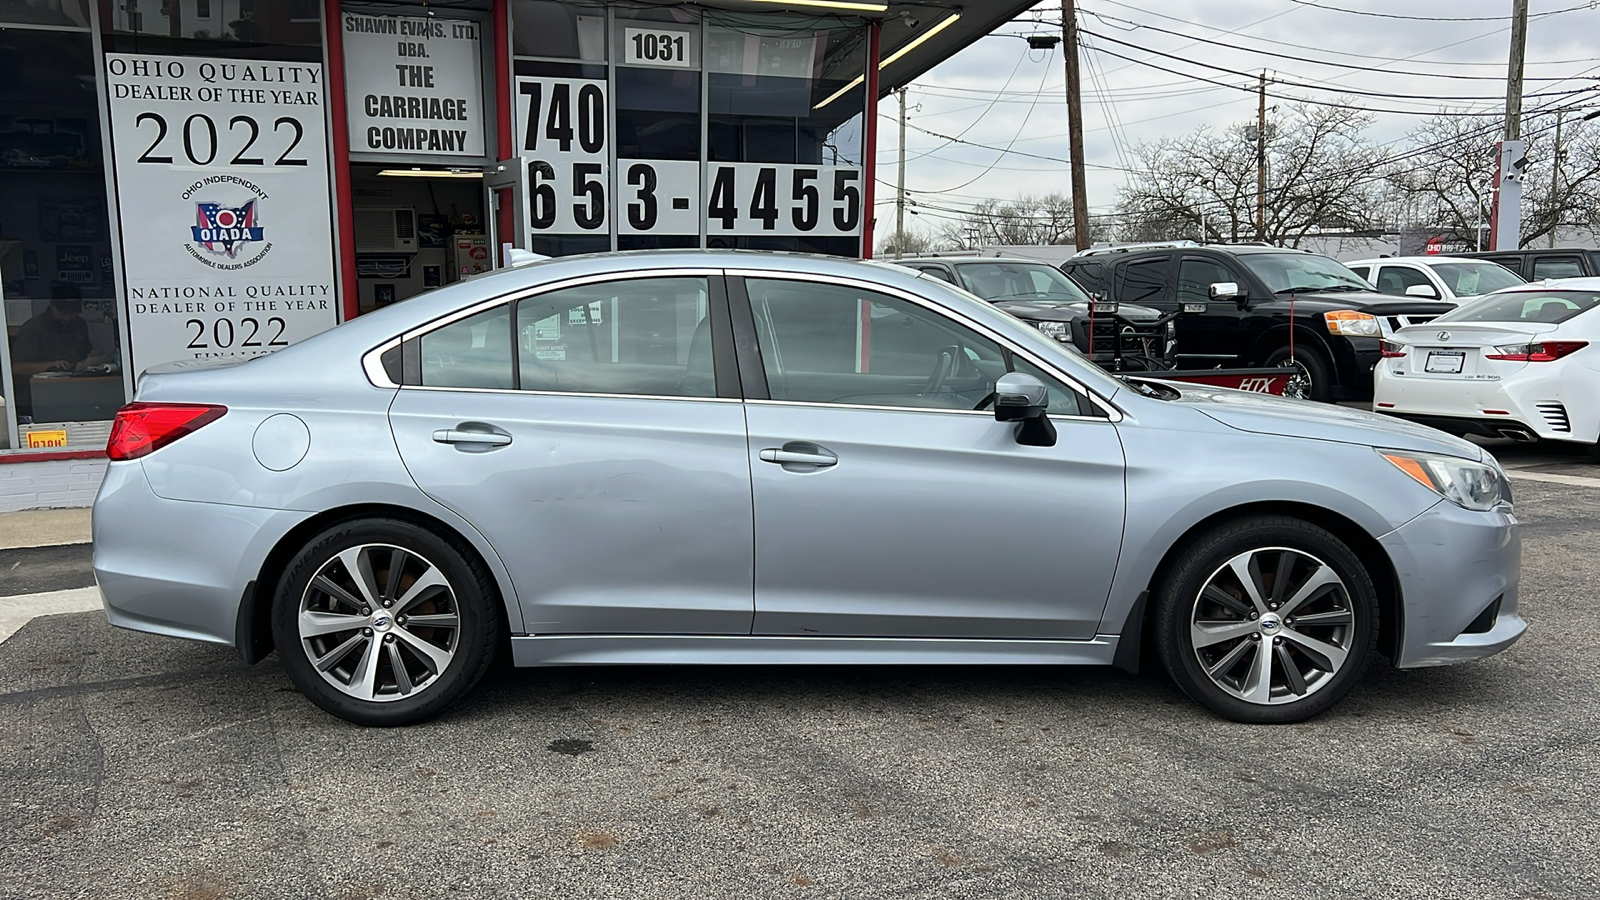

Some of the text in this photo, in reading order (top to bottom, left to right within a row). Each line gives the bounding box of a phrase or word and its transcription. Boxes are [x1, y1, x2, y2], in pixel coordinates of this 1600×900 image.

[345, 17, 478, 40] SHAWN EVANS. LTD.
[397, 41, 430, 58] DBA.
[632, 33, 684, 62] 1031
[109, 58, 320, 84] OHIO QUALITY
[395, 64, 435, 88] THE
[113, 83, 319, 106] DEALER OF THE YEAR
[364, 94, 468, 121] CARRIAGE
[519, 81, 605, 154] 740
[135, 112, 308, 166] 2022
[366, 126, 468, 152] COMPANY
[181, 175, 270, 201] OHIO INDEPENDENT
[200, 228, 252, 241] OIADA
[183, 242, 274, 271] AUTOMOBILE DEALERS ASSOCIATION
[132, 285, 329, 299] NATIONAL QUALITY
[135, 300, 329, 314] DEALER OF THE YEAR
[186, 316, 289, 350] 2022
[1239, 377, 1277, 393] HTX
